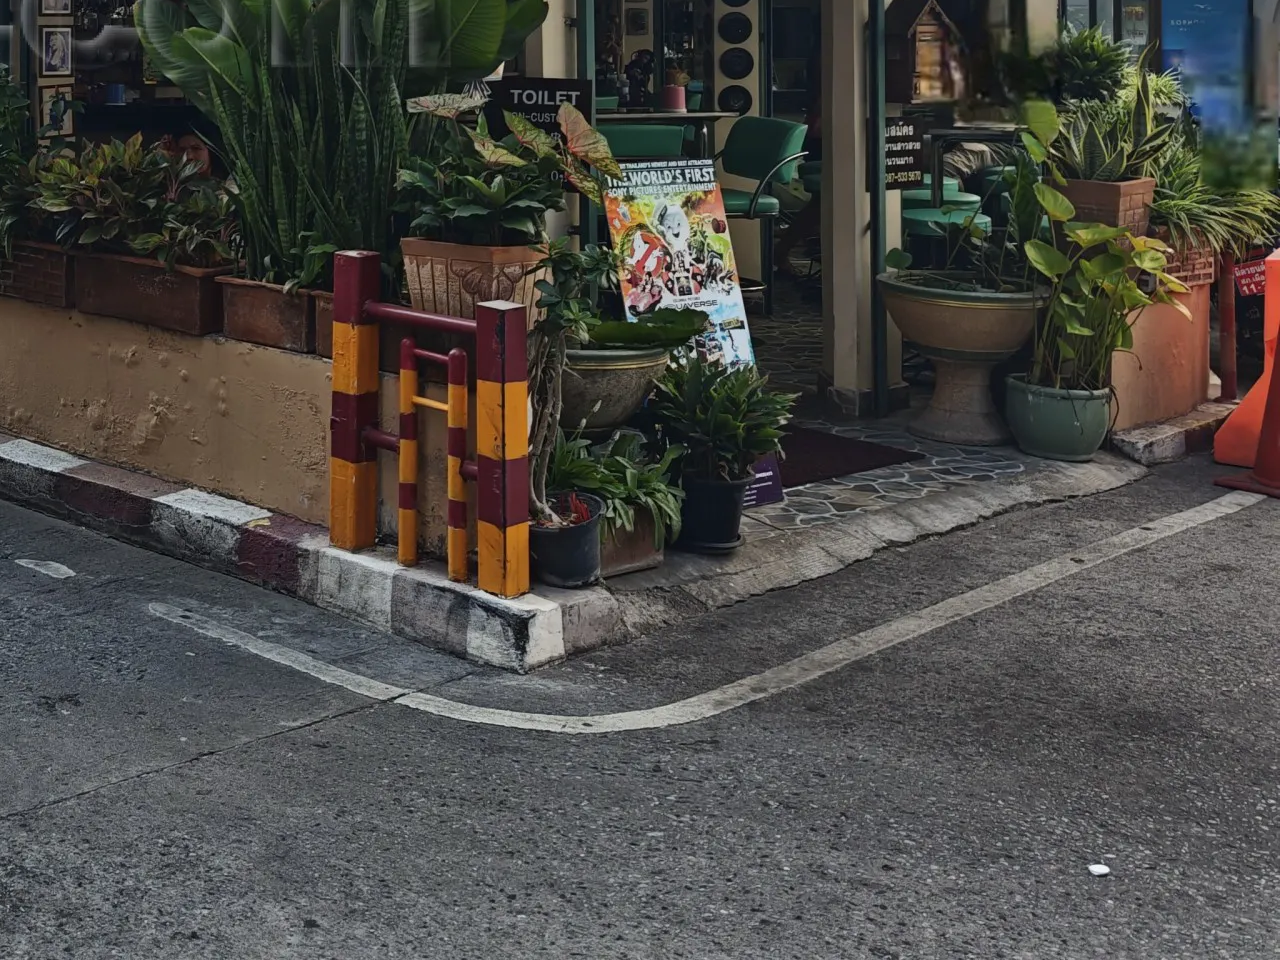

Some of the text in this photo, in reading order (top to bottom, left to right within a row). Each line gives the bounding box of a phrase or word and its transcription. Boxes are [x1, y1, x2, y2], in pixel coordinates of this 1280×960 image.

[510, 89, 581, 105] TOILET
[629, 169, 683, 186] WORLD'S
[685, 168, 715, 182] FIRST
[608, 183, 717, 196] SONY PICTURES ENTERTAINMENT
